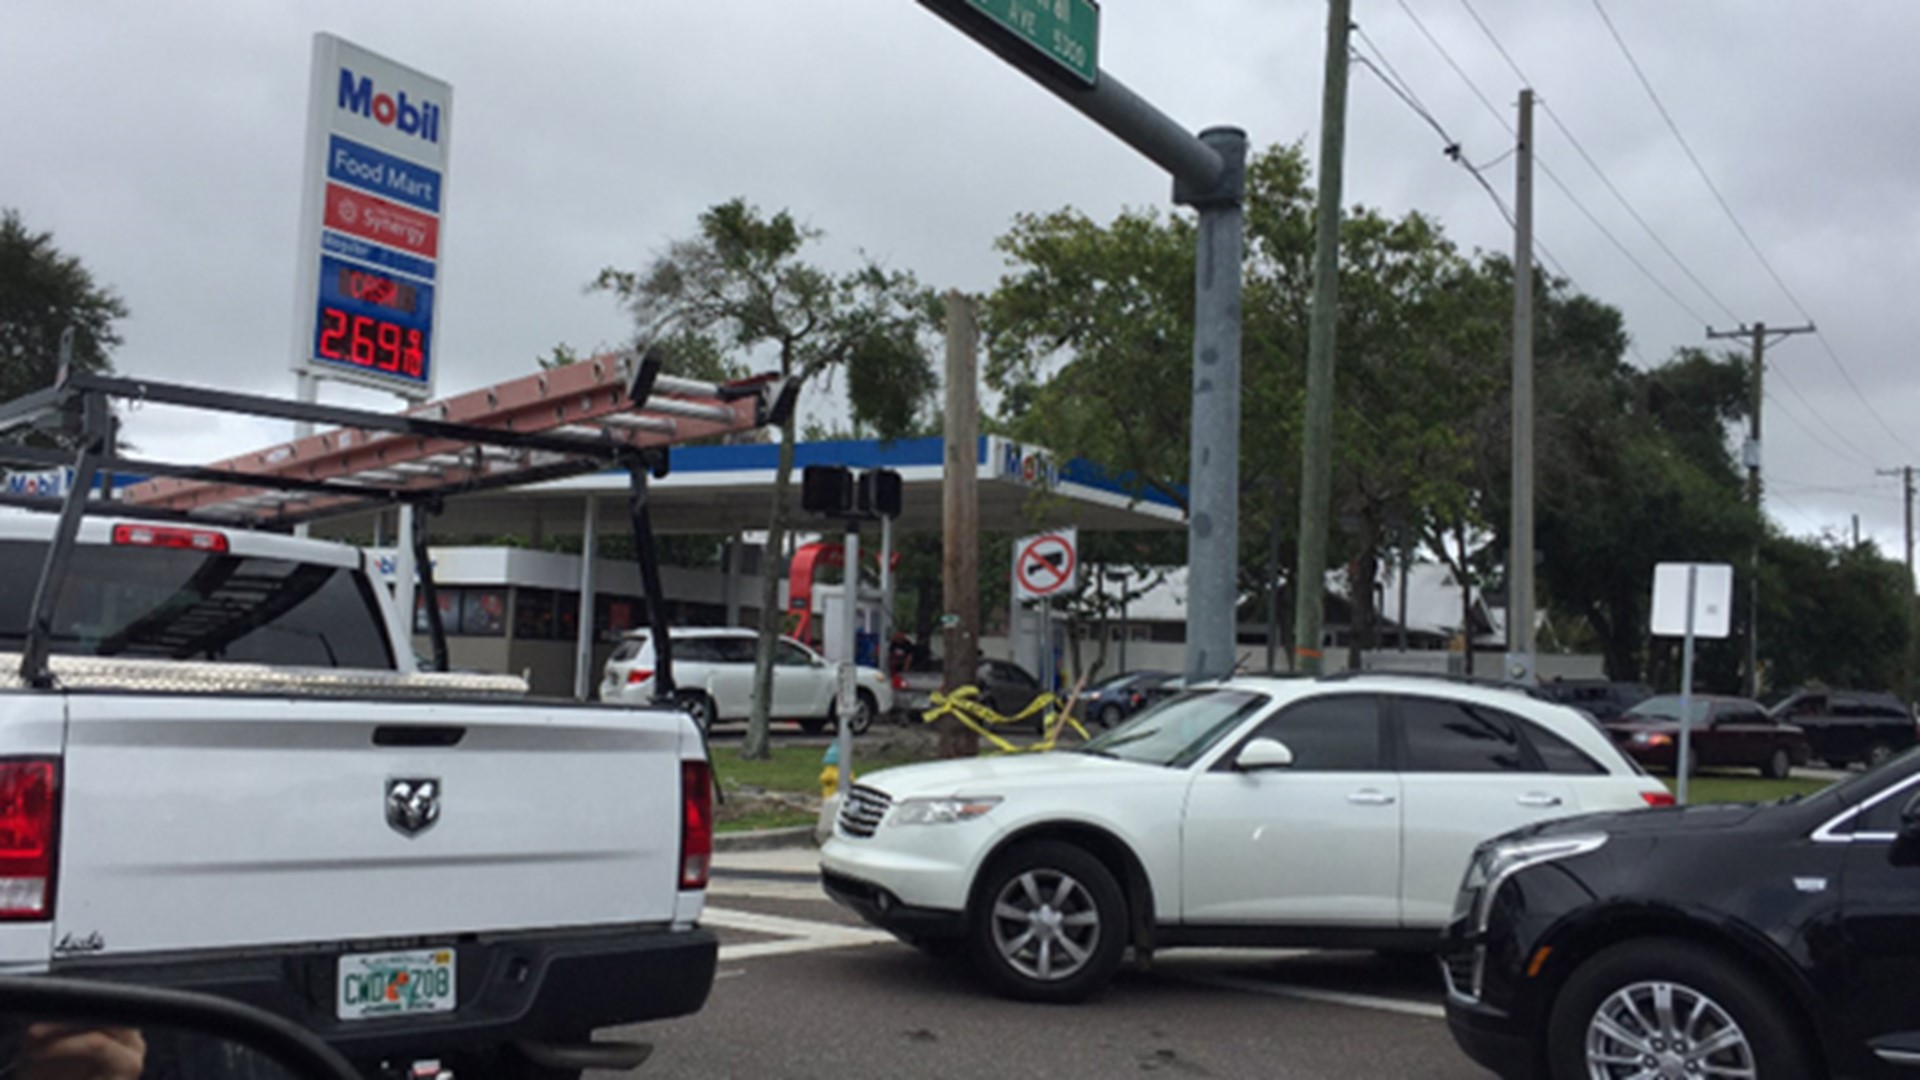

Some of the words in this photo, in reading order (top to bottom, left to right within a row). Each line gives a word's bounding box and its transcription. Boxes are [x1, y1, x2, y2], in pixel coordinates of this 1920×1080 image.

[337, 66, 440, 144] Mobil
[334, 148, 385, 184] Food
[387, 167, 433, 201] Mart
[363, 207, 426, 246] Synergy
